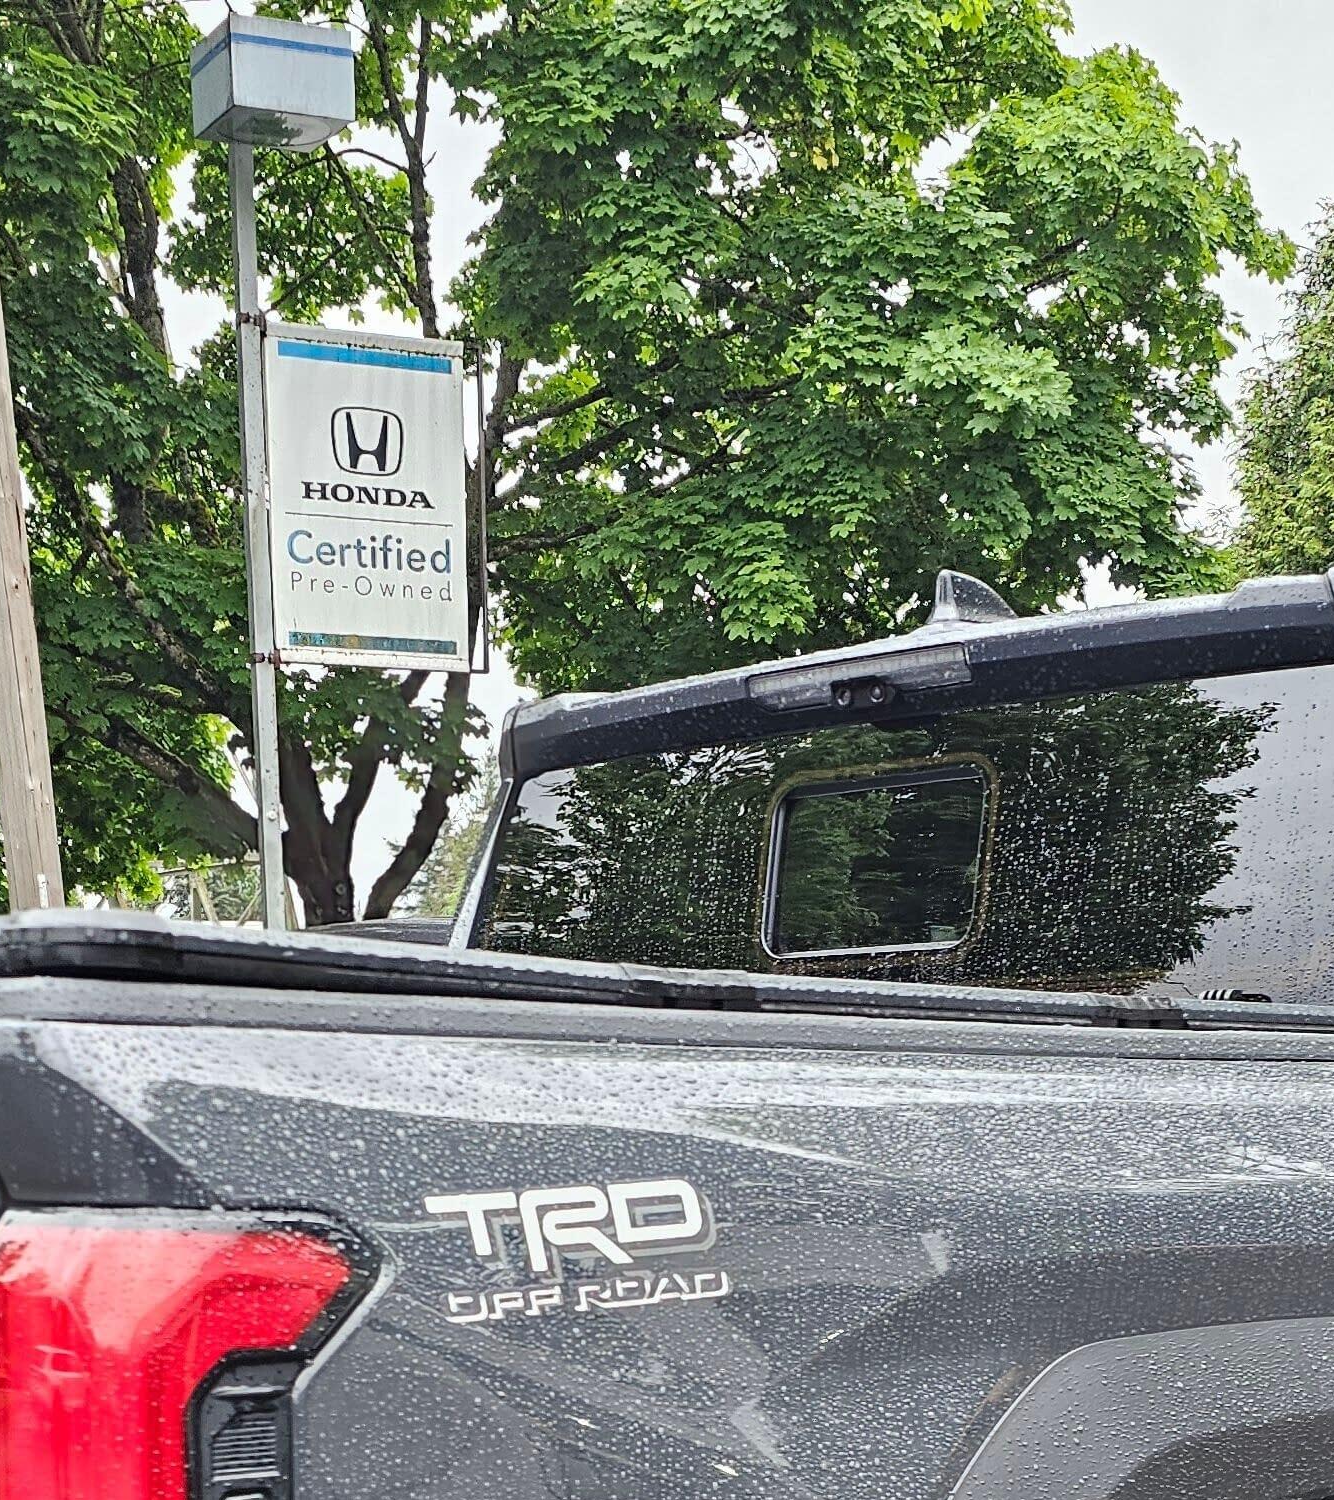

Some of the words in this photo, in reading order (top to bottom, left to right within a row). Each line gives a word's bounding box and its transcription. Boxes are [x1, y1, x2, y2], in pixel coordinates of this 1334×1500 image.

[301, 481, 436, 509] HONDA
[287, 529, 452, 574] Certified
[291, 571, 453, 602] Pre-Owned
[424, 1179, 703, 1272] TRD
[444, 1285, 562, 1323] OFF
[574, 1271, 729, 1312] ROAD
